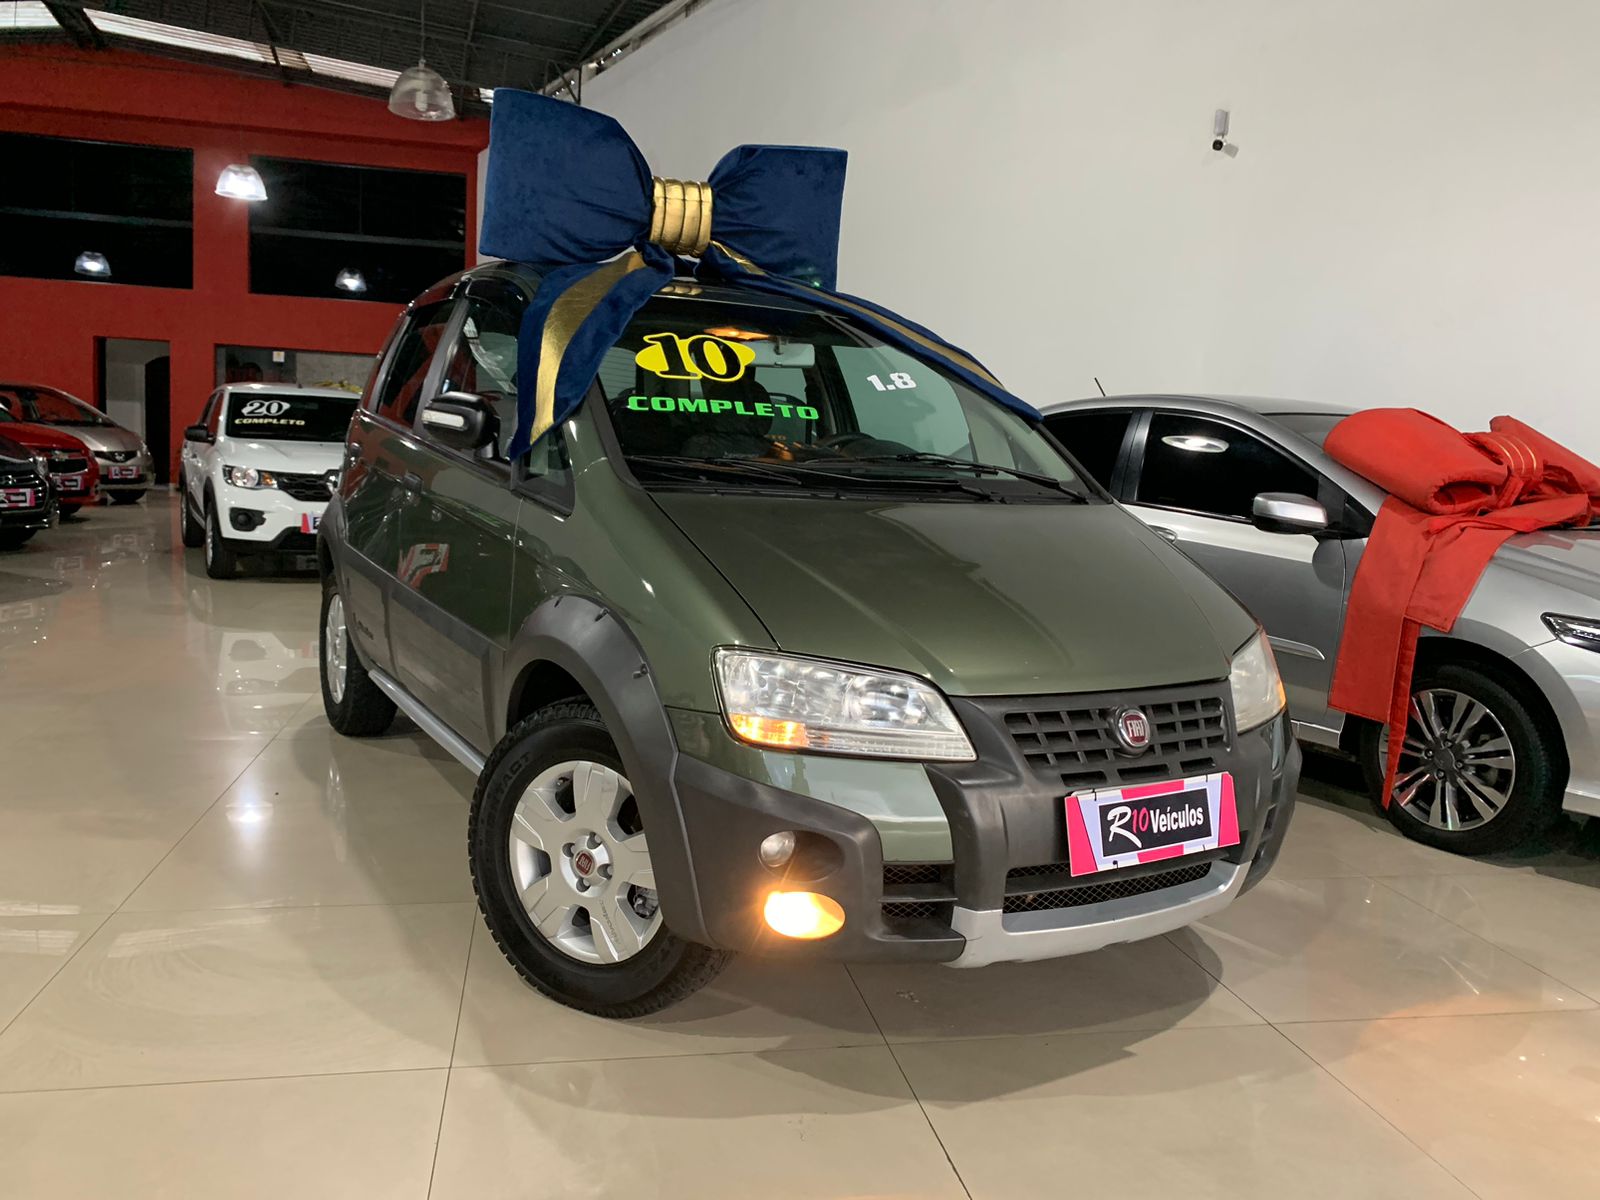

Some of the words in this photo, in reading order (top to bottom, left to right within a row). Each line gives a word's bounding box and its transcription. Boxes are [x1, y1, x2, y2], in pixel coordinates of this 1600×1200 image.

[642, 332, 745, 382] 10
[866, 372, 917, 392] 1.8
[245, 400, 285, 416] 20
[627, 396, 820, 420] COMPLETO
[234, 418, 306, 426] COMPLETO
[1126, 719, 1145, 738] FIAT
[1150, 803, 1204, 833] Veículos
